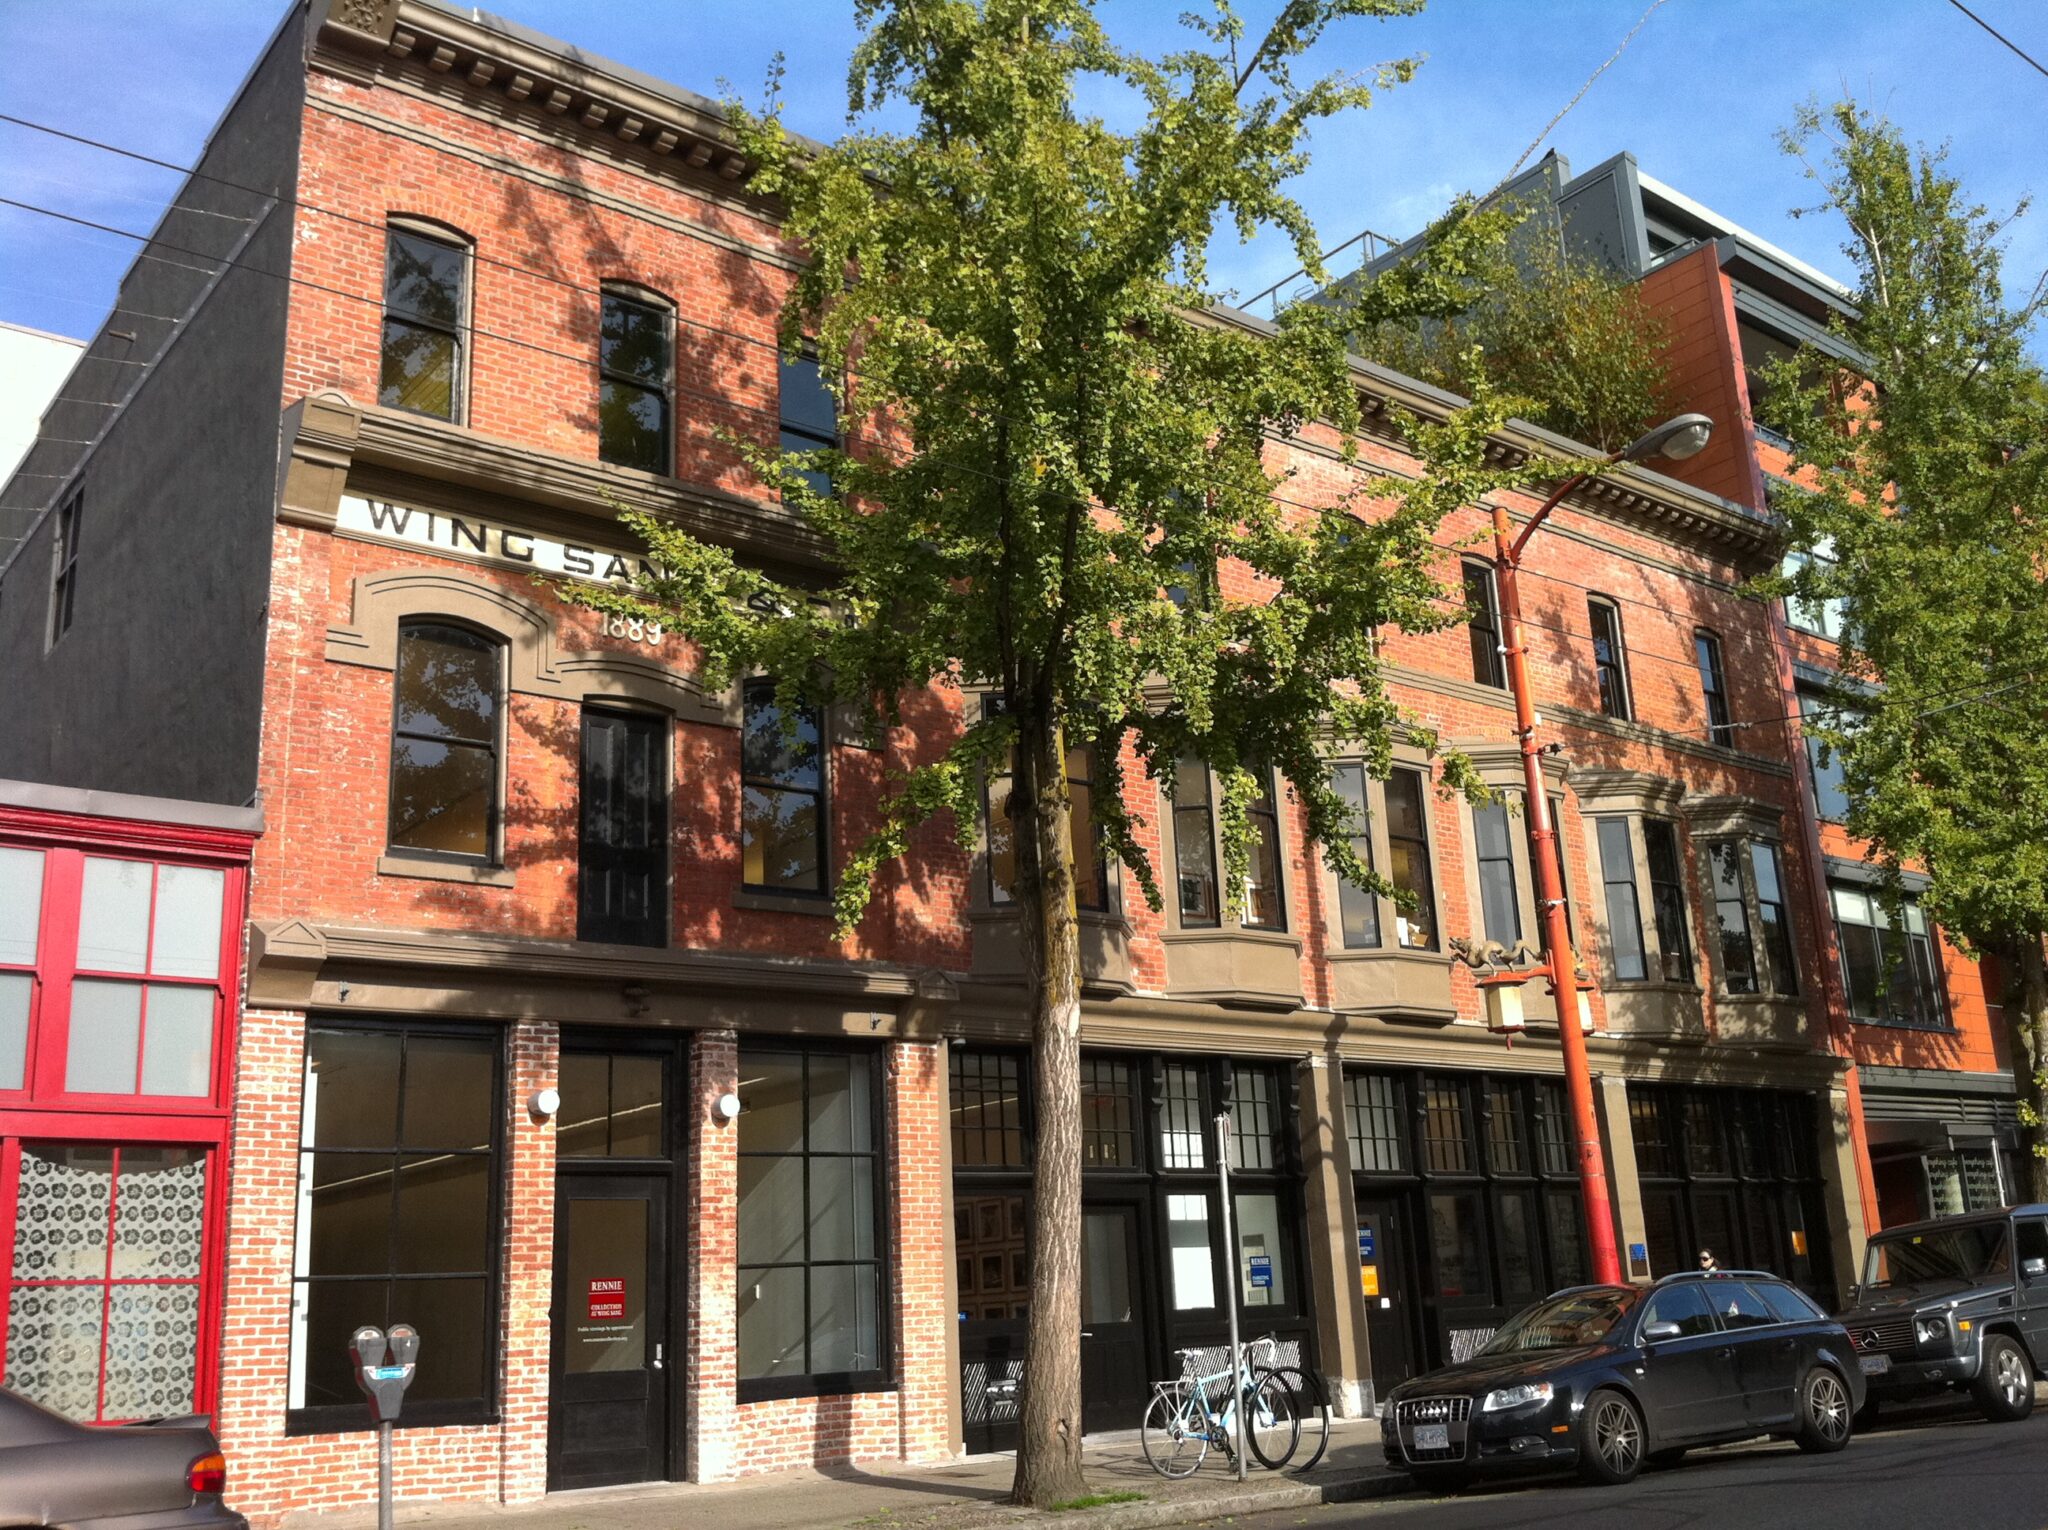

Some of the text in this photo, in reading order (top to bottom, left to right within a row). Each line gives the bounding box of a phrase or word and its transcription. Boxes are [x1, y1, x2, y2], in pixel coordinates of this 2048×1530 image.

[366, 498, 535, 563] WING
[563, 543, 690, 593] SAN
[599, 611, 662, 646] 1889
[591, 1281, 622, 1291] RENNIE
